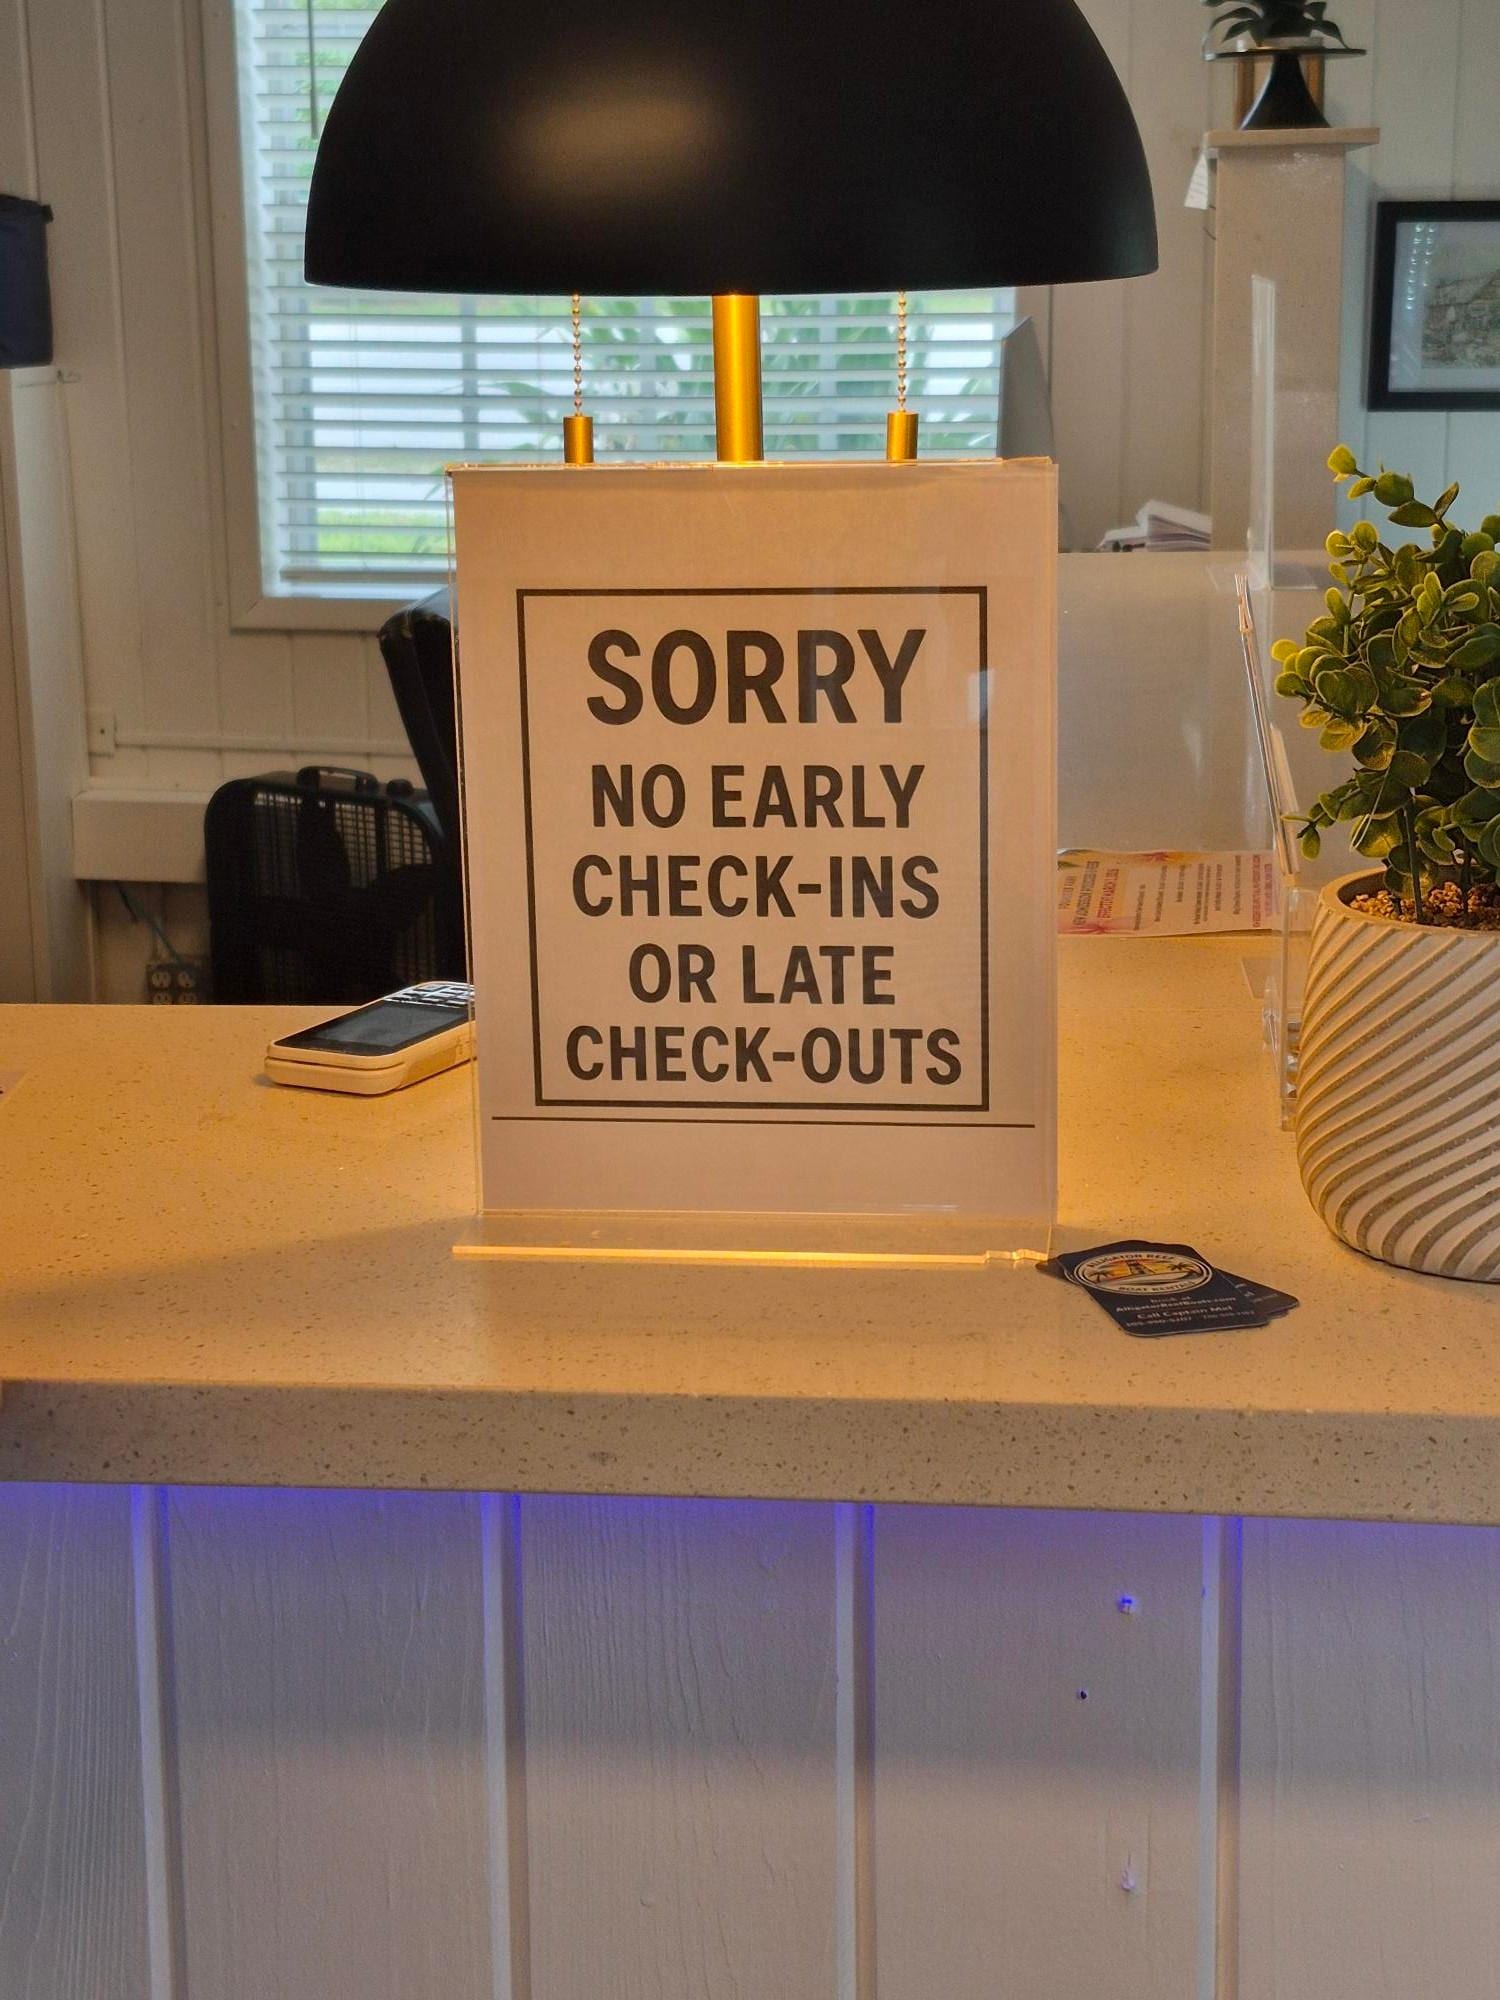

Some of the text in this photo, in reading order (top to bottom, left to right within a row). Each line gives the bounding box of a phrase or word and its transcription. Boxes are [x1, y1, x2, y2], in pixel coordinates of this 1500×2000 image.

[587, 629, 926, 725] SORRY
[591, 763, 926, 828] NO EARLY
[572, 854, 940, 919] CHECK-INS
[629, 943, 896, 1005] OR LATE
[566, 1025, 962, 1085] CHECK-OUTS
